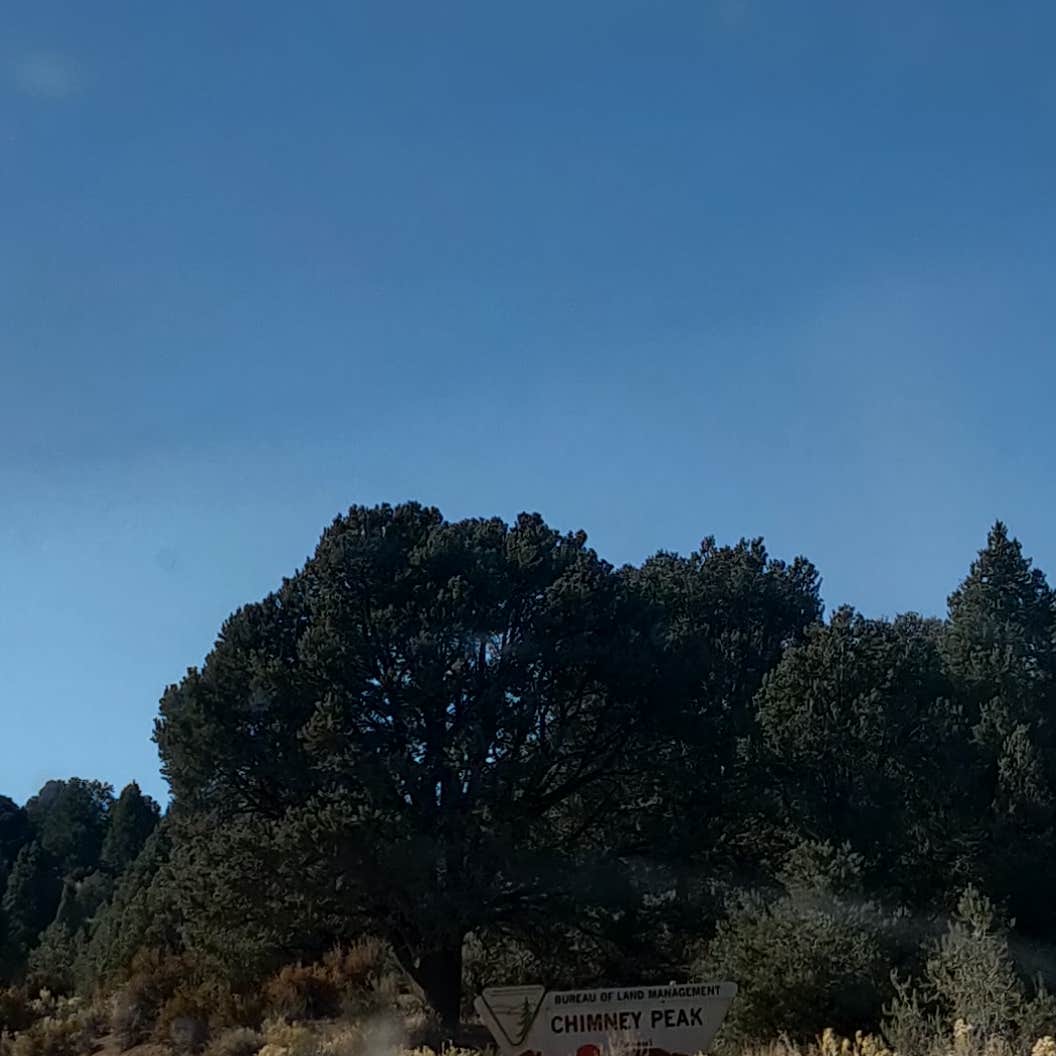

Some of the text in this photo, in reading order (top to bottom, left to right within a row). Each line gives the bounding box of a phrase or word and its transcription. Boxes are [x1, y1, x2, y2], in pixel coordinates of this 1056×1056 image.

[554, 985, 721, 1005] BUREAU OF LAND MANAGEMENT
[551, 1008, 703, 1034] CHIMNEY PEAK
